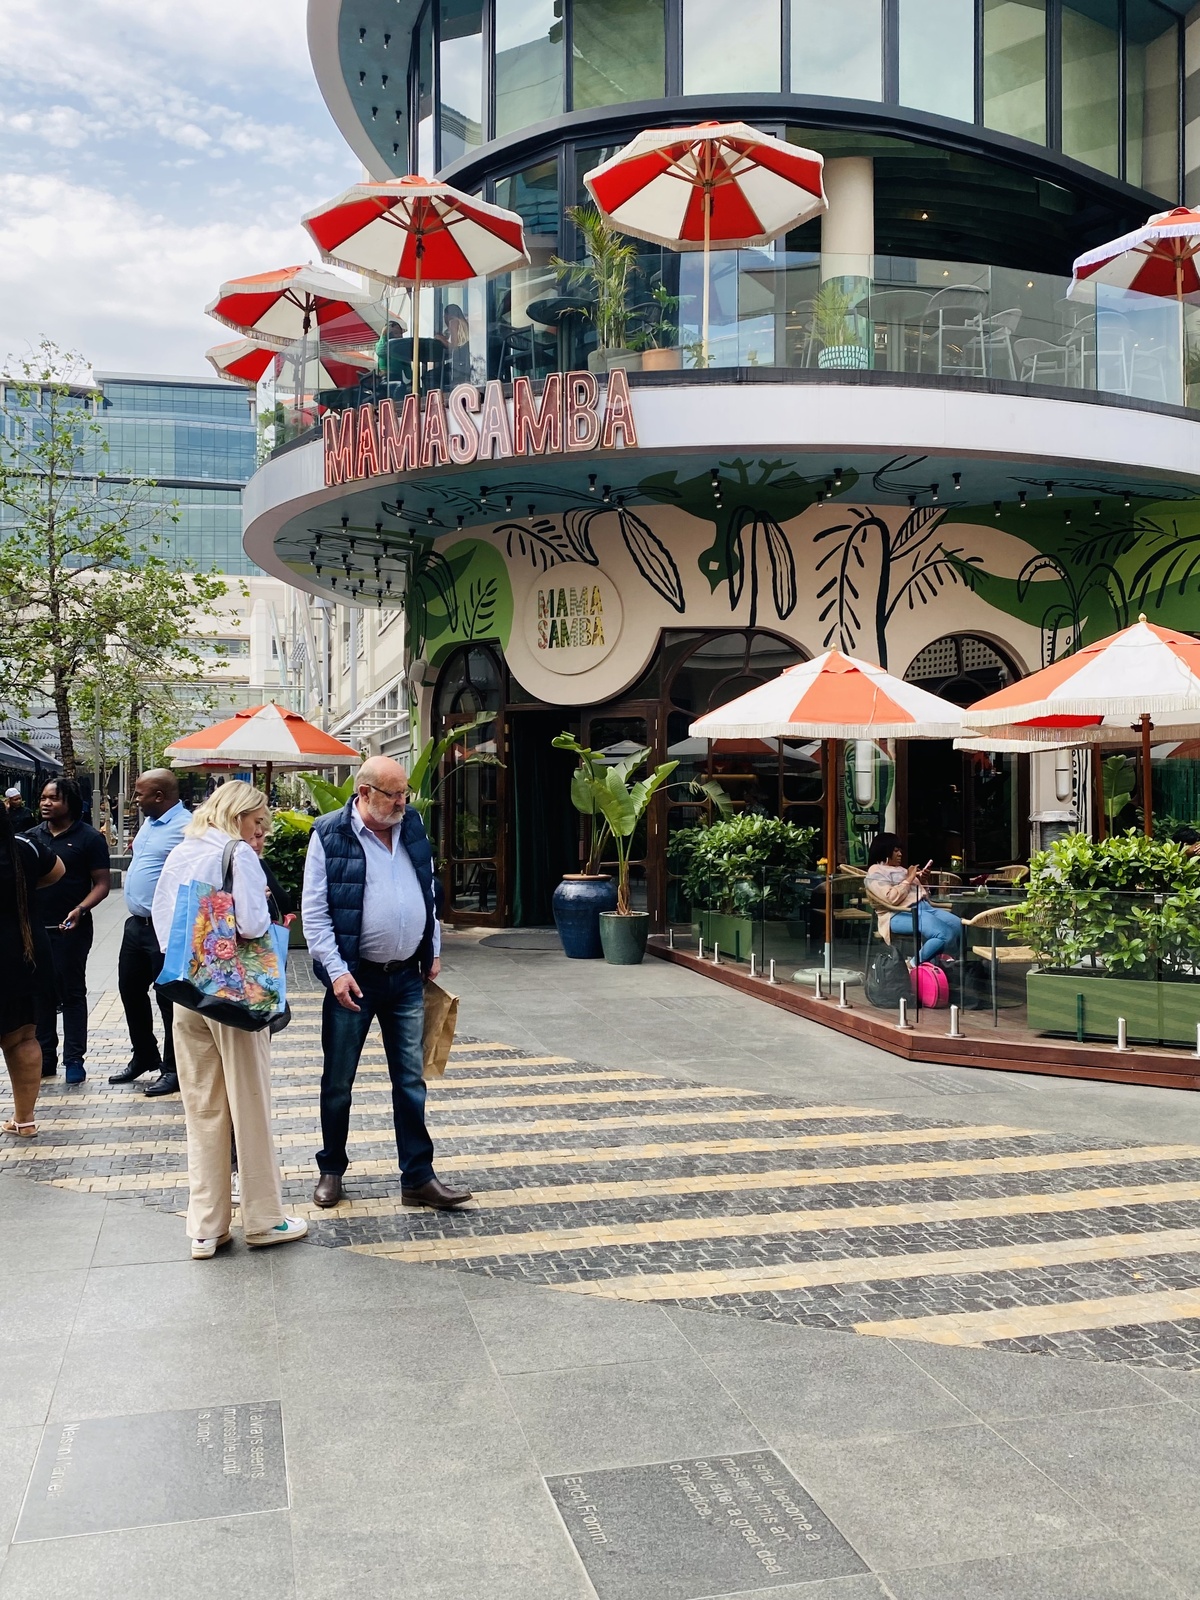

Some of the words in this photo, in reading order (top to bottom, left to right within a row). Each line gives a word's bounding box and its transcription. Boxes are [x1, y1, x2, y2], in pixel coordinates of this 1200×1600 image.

[537, 585, 603, 619] MAMA
[537, 616, 605, 650] SAMBA
[57, 1423, 80, 1456] Nelson
[222, 1406, 241, 1453] impossible
[246, 1414, 265, 1445] always
[223, 1454, 241, 1475] until
[250, 1446, 265, 1479] seems
[669, 1464, 690, 1474] of
[695, 1461, 719, 1482] only
[719, 1457, 755, 1491] master
[709, 1483, 738, 1506] after
[745, 1490, 764, 1503] in
[752, 1463, 784, 1487] shall
[771, 1488, 813, 1531] become
[805, 1532, 821, 1542] a
[564, 1476, 590, 1504] Erich
[577, 1504, 608, 1545] Fromm
[727, 1508, 742, 1517] a
[754, 1503, 779, 1524] this
[729, 1518, 767, 1549] great
[770, 1525, 795, 1542] art
[756, 1550, 790, 1576] deal
